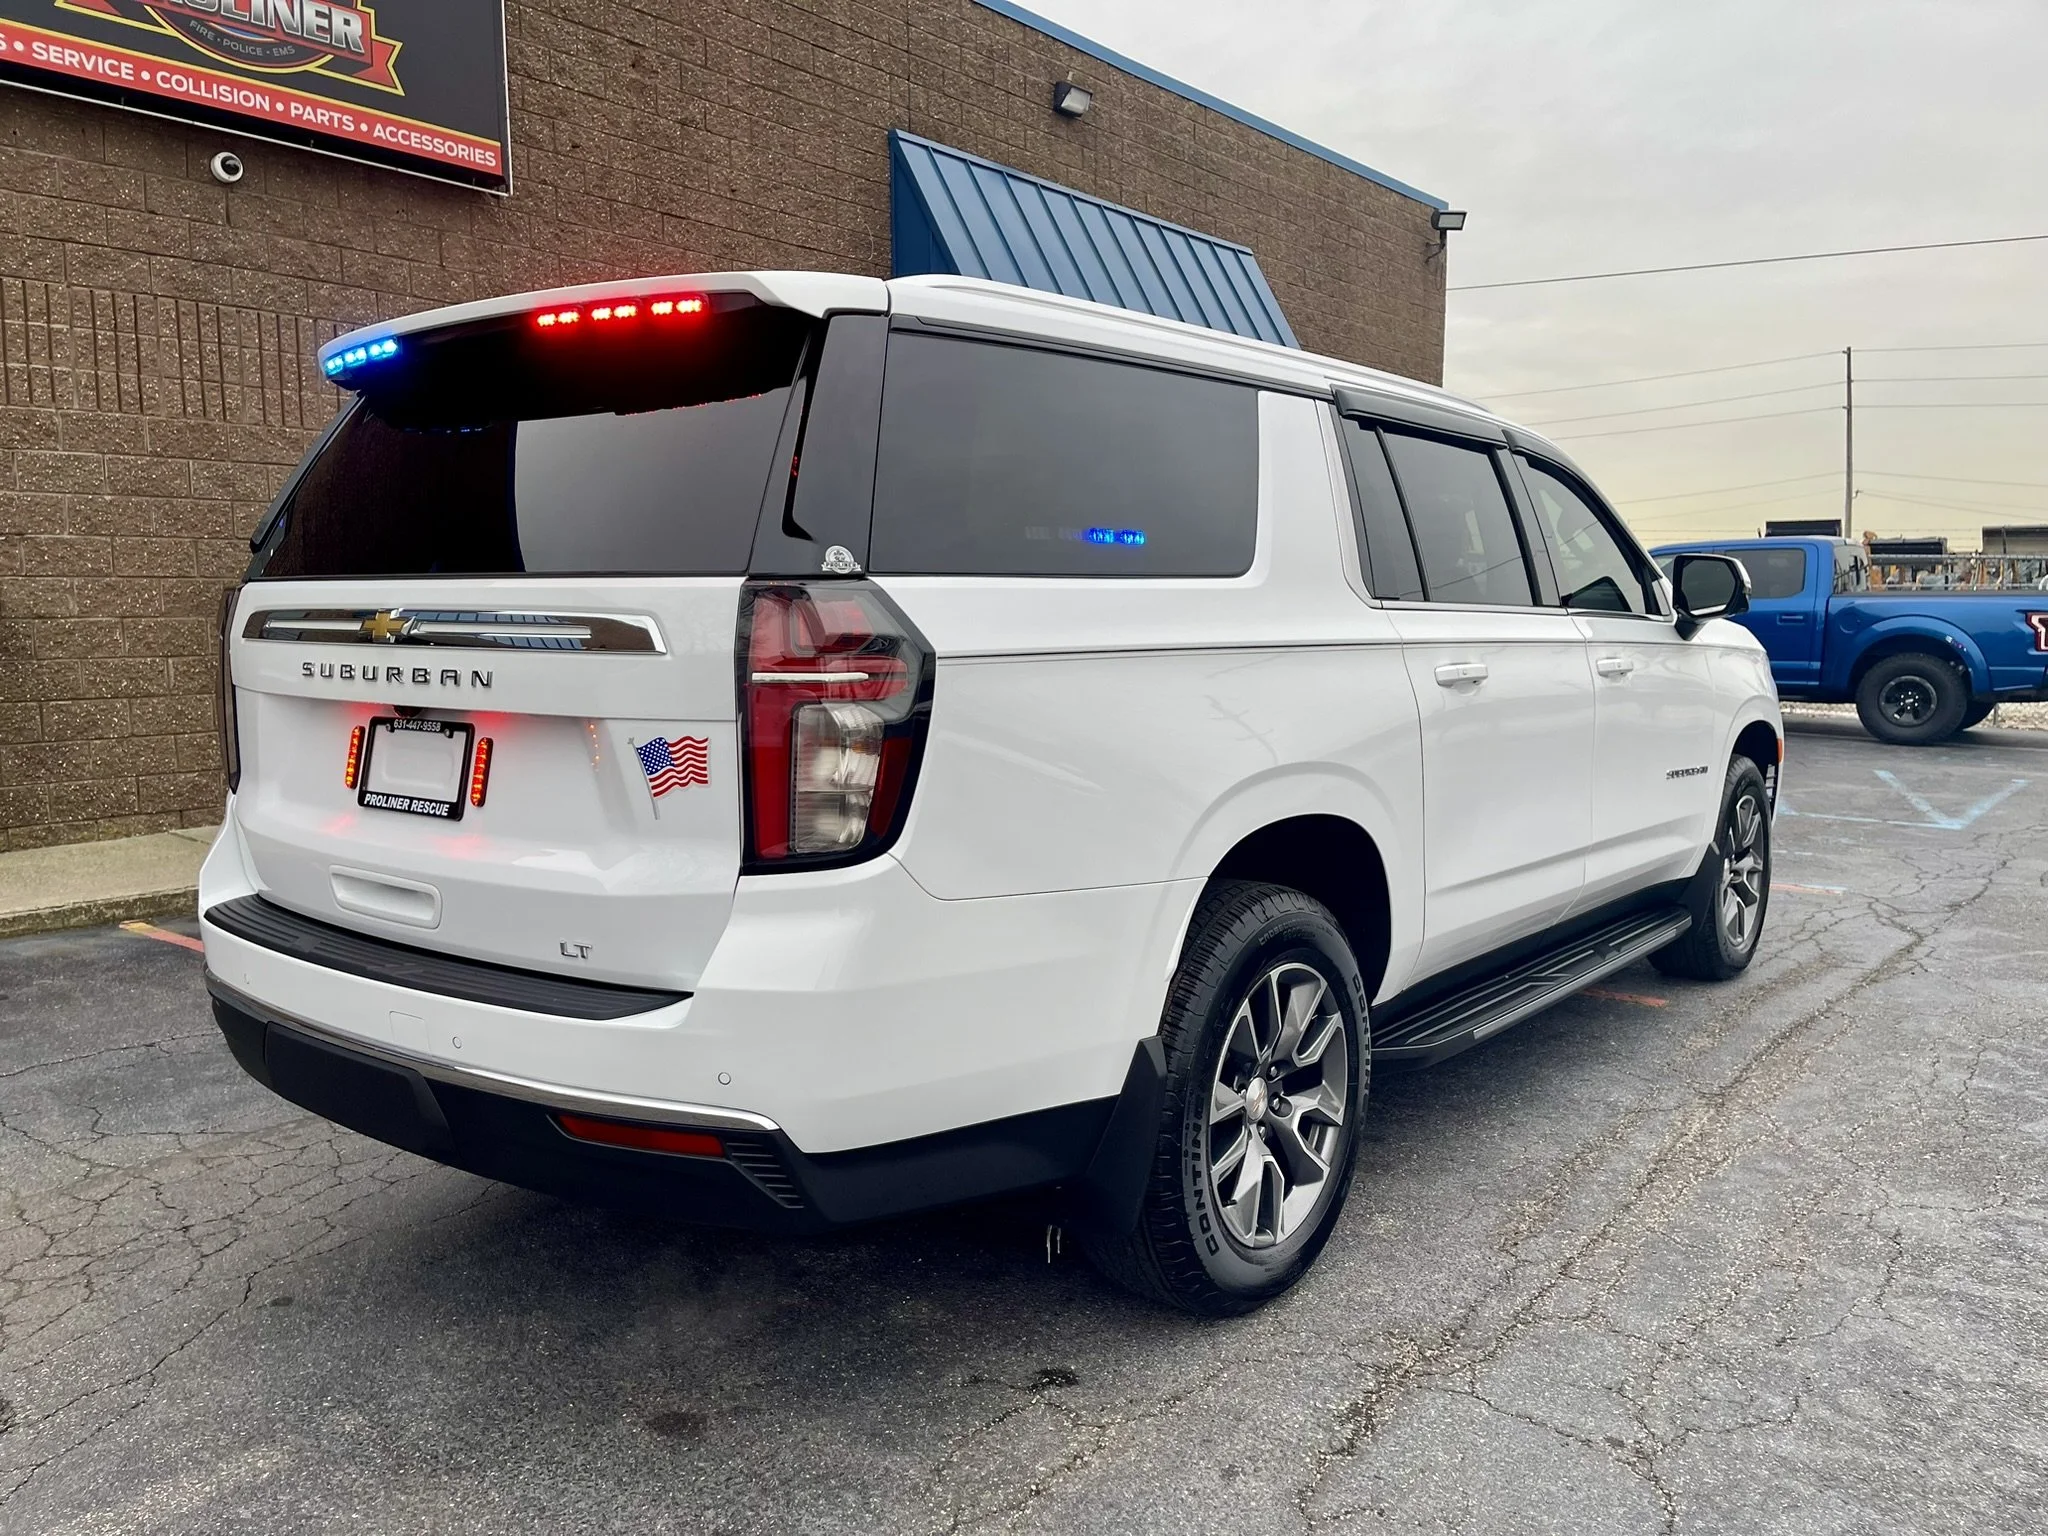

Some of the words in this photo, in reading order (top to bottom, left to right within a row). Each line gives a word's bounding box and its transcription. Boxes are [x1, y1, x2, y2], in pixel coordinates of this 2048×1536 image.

[189, 19, 214, 41] FIRE
[222, 38, 263, 56] POLICE
[272, 45, 295, 57] EMS
[32, 41, 135, 80] SERVICE
[156, 71, 270, 112] COLLISION
[290, 102, 355, 132] PARTS
[373, 123, 496, 167] ACCESSORIES
[302, 662, 493, 688] SUBURBAN
[393, 719, 441, 732] 631-447-9558
[364, 793, 410, 811] PROLINER
[410, 800, 450, 816] RESCUE
[560, 941, 592, 959] LT
